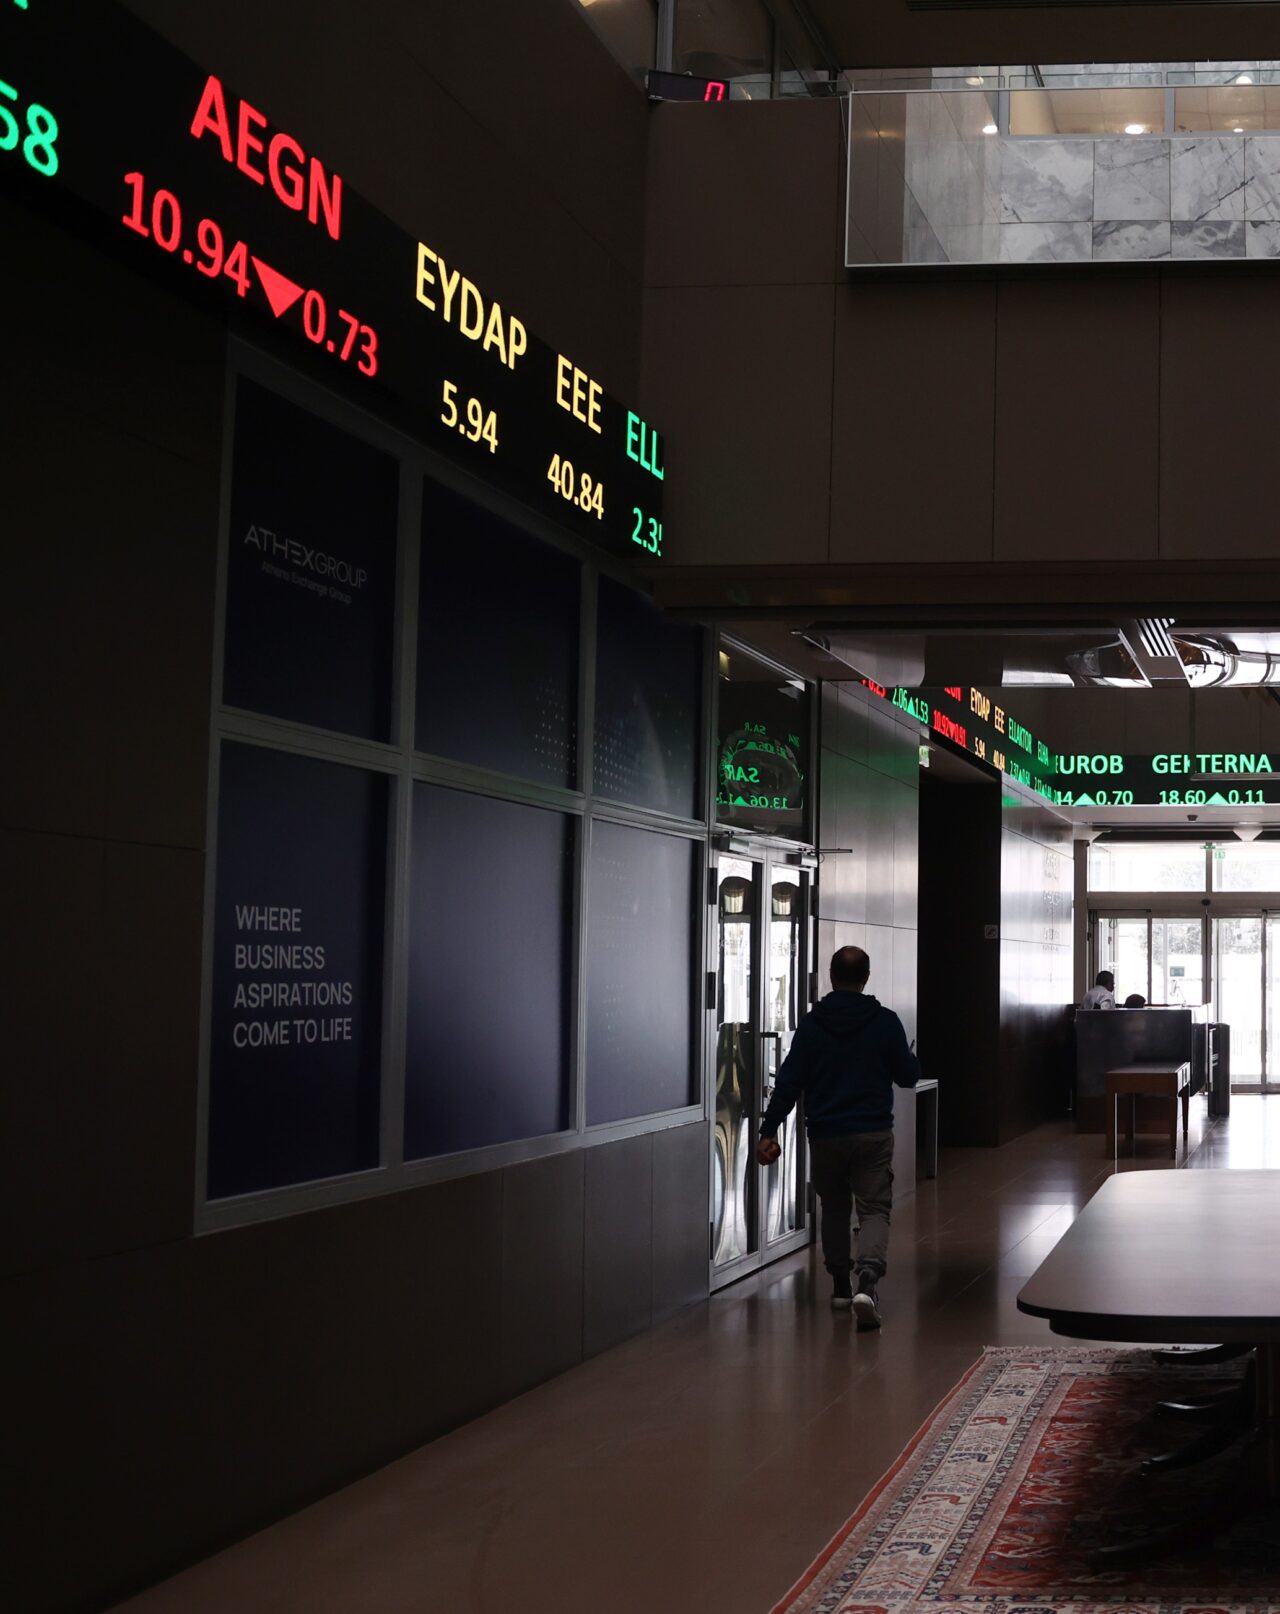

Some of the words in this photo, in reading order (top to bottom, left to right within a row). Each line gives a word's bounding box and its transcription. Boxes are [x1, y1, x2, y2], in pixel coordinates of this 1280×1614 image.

[191, 76, 342, 240] AEGN
[123, 172, 250, 297] 10.94
[303, 290, 377, 376] 0.73
[416, 242, 526, 369] EYDAP
[557, 354, 602, 433] EEE
[627, 411, 663, 480] ELL
[441, 380, 498, 453] 5.94
[548, 454, 604, 519] 40.84
[970, 687, 990, 722] EYDAP
[994, 705, 1005, 734] EEE
[1096, 790, 1134, 804] 0.70
[1159, 789, 1206, 804] 18.60
[1228, 789, 1265, 804] 0.11
[235, 904, 302, 932] WHERE
[234, 944, 325, 970] BUSINESS
[233, 982, 353, 1009] ASPIRATIONS
[233, 1020, 290, 1048] COME
[293, 1018, 317, 1043] TO
[321, 1017, 352, 1042] LIFE
